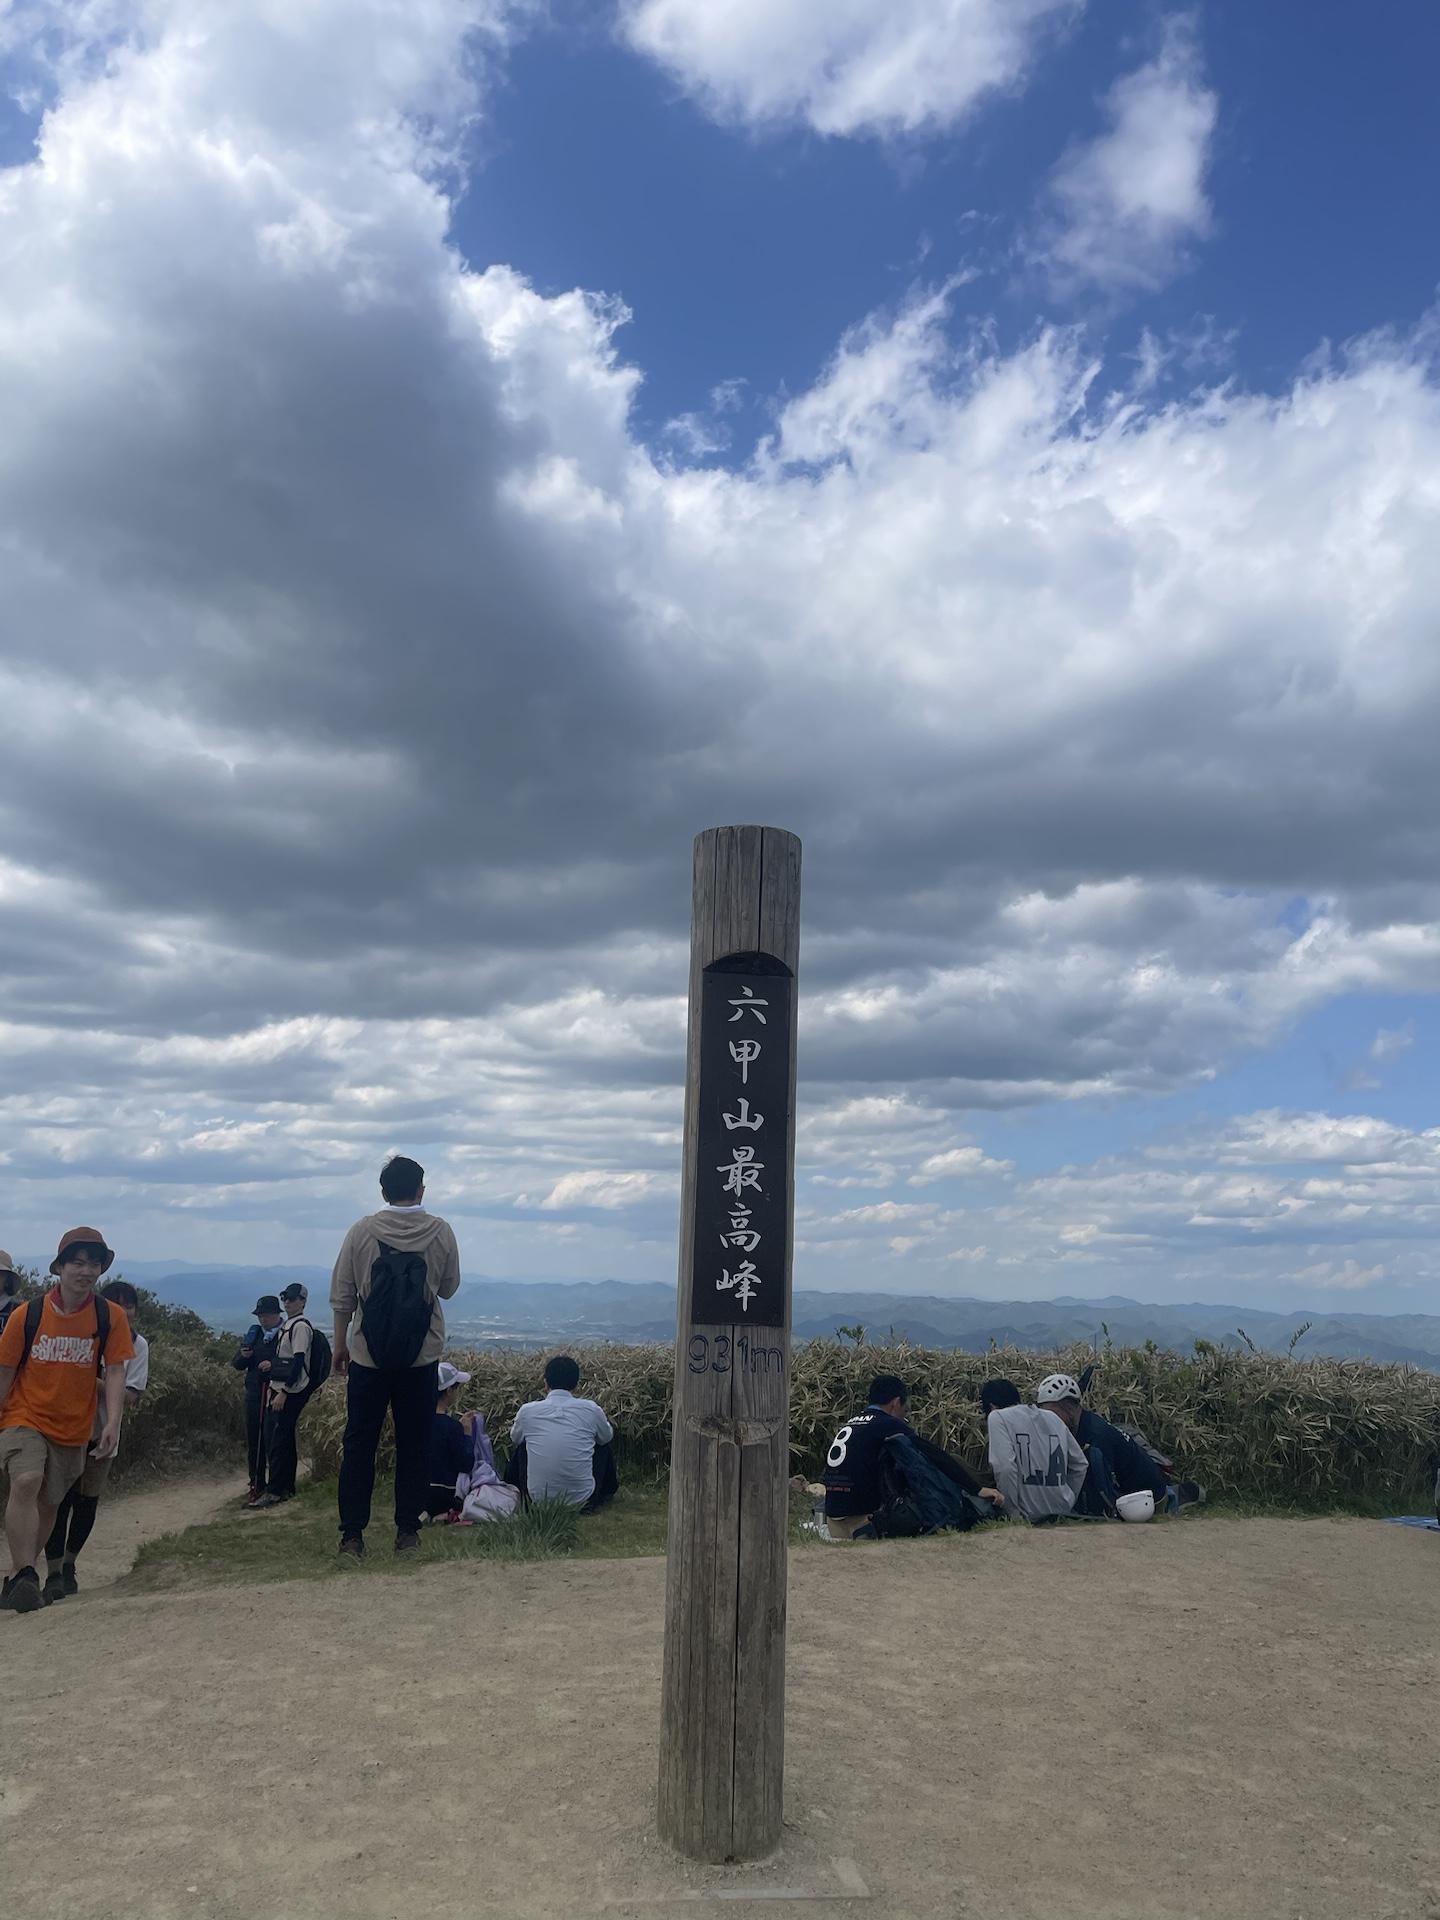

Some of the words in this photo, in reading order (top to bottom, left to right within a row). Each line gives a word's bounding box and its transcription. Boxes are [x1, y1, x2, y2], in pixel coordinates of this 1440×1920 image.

[715, 985, 769, 1312] 六甲山最高峰
[688, 1334, 783, 1374] 931m
[827, 1426, 853, 1467] 8
